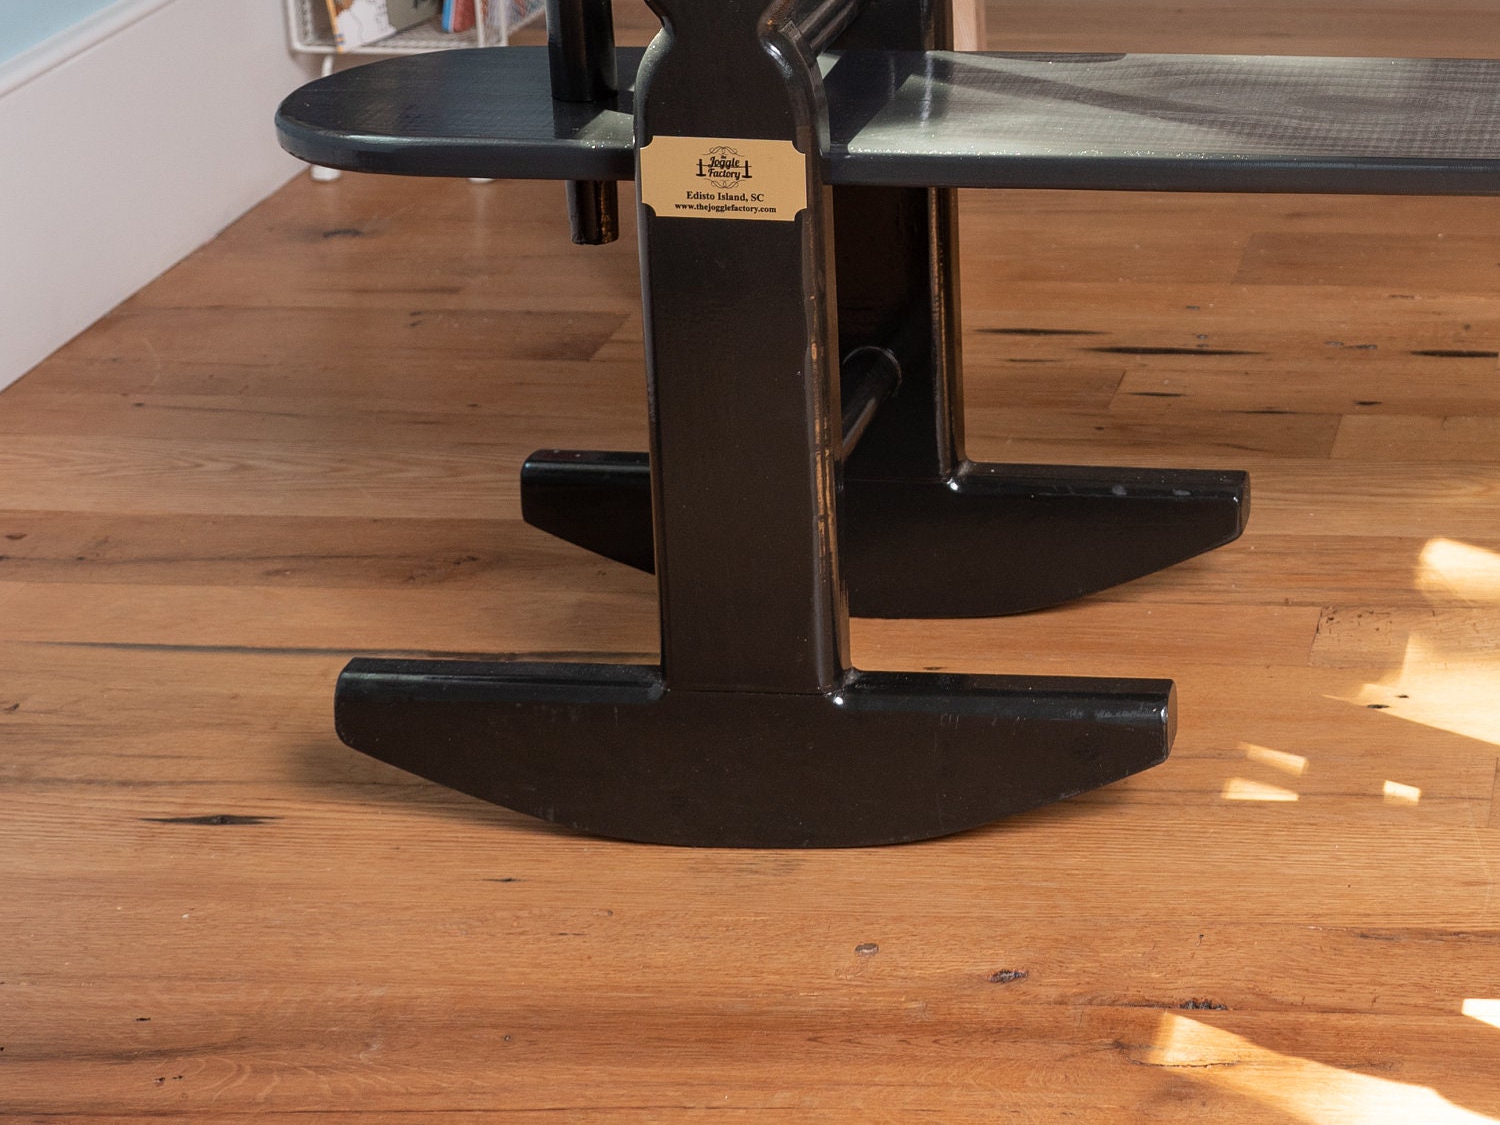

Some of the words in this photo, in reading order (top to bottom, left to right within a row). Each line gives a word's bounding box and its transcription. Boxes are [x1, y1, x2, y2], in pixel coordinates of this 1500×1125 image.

[708, 156, 740, 170] Joggle
[708, 168, 741, 181] Factory
[686, 191, 715, 201] Edisto
[717, 192, 749, 203] Island,
[750, 193, 765, 202] SC
[674, 203, 777, 214] www.thejogglefactory.com
